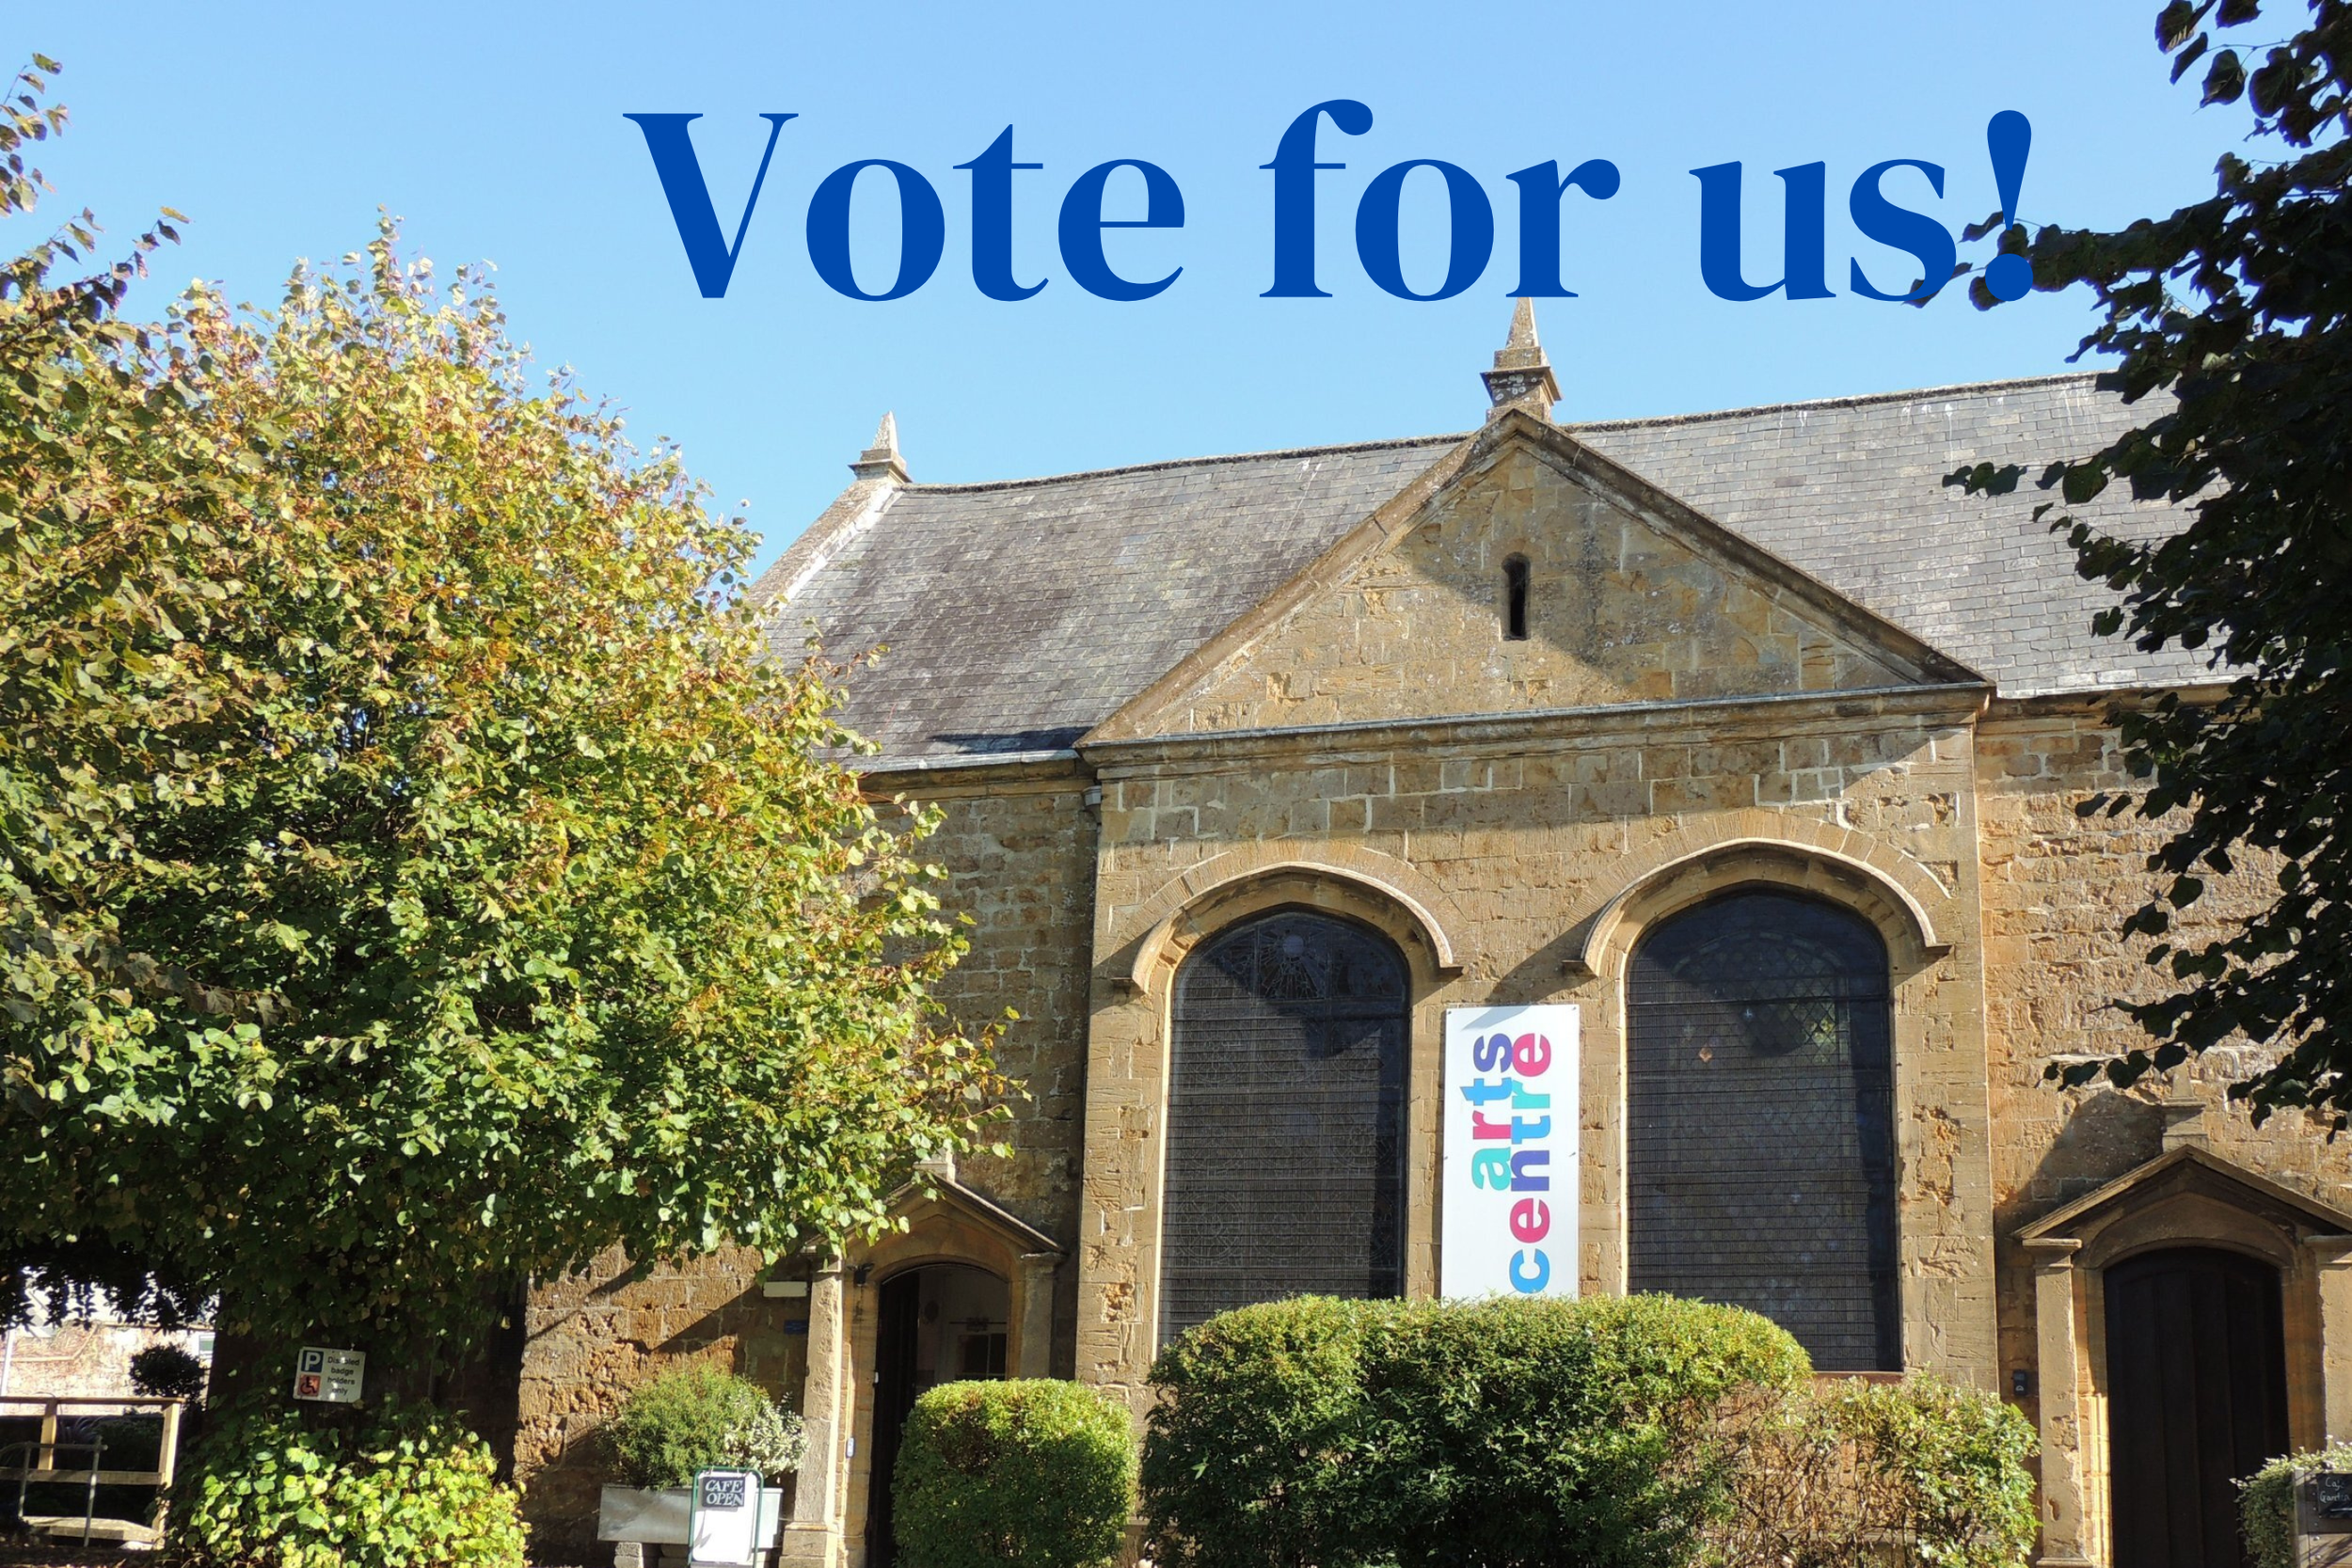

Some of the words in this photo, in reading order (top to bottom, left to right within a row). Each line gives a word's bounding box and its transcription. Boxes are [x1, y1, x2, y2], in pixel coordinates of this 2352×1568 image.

[1460, 1033, 1513, 1192] arts
[1509, 1033, 1551, 1294] centre
[304, 1352, 321, 1370] P
[327, 1355, 360, 1366] Disbled
[330, 1367, 354, 1376] badge
[327, 1375, 356, 1385] holders
[705, 1480, 743, 1493] CAFE
[707, 1492, 744, 1506] OPEN
